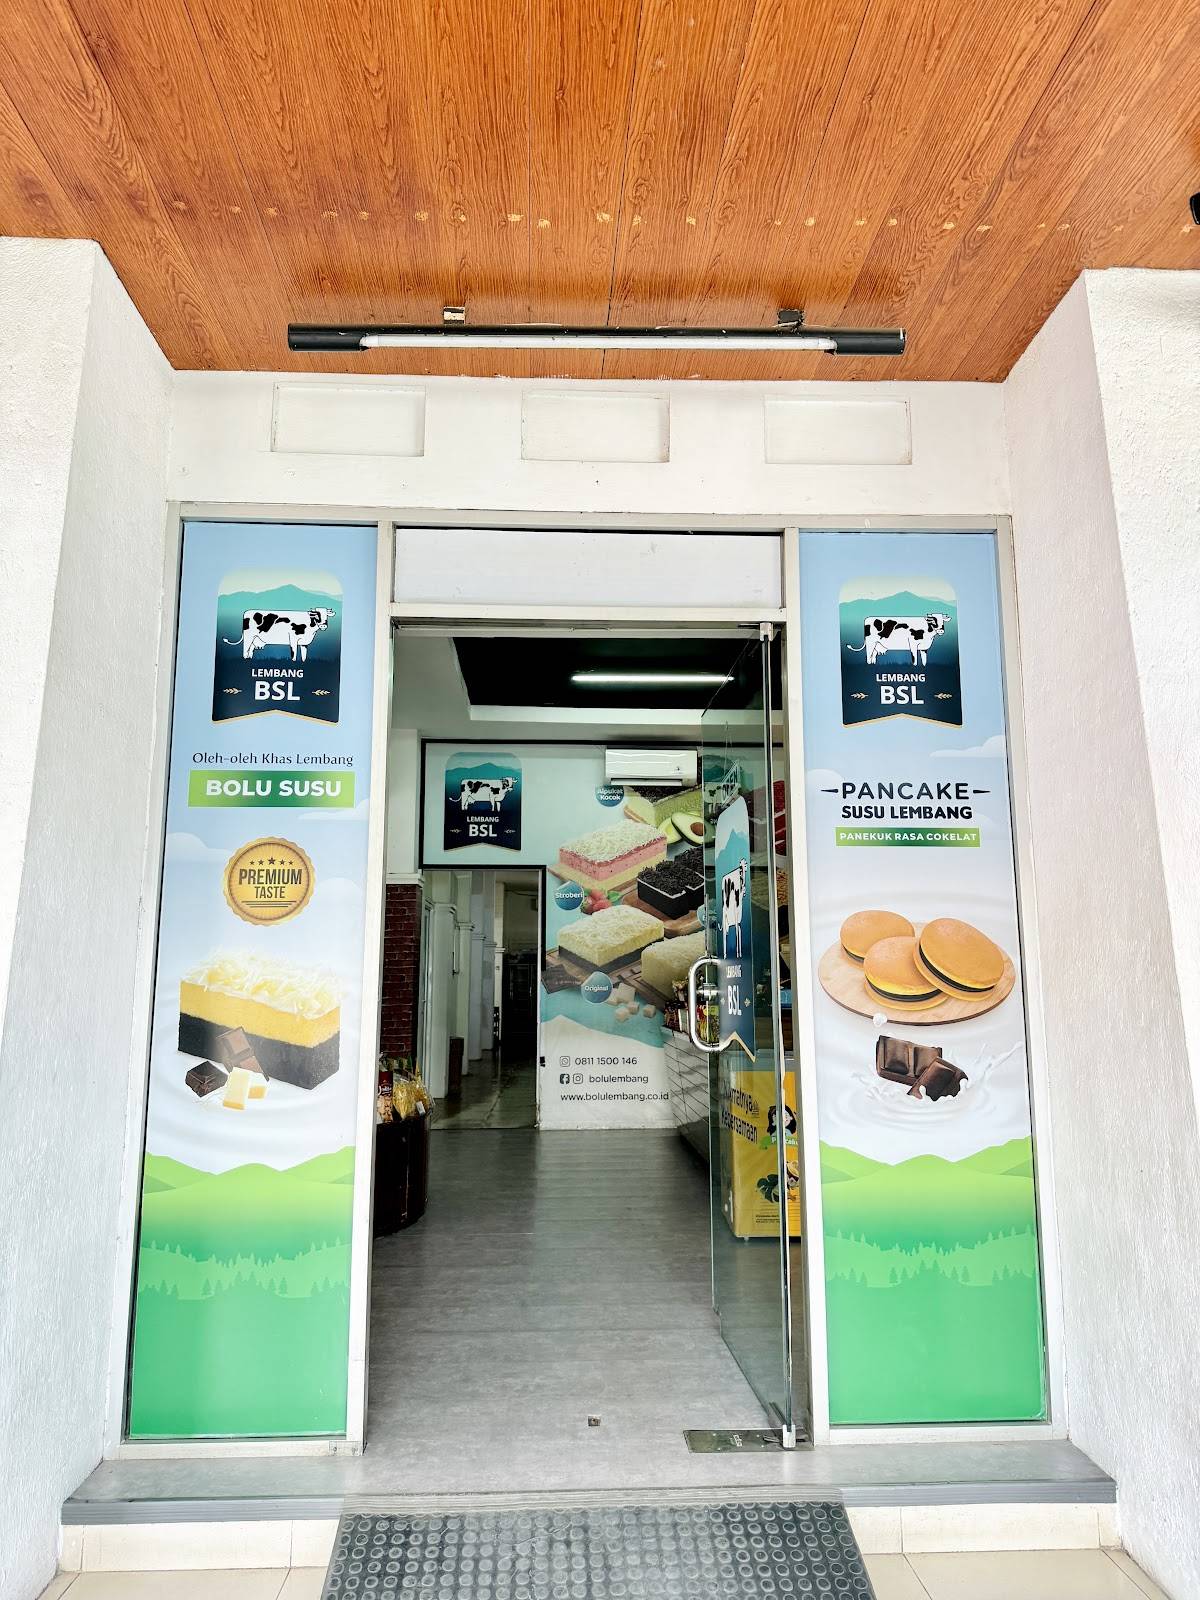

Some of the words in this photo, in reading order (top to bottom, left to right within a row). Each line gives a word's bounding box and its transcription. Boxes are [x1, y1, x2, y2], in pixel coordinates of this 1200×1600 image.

[251, 668, 304, 678] LEMBANG
[876, 673, 926, 682] LEMBANG
[254, 680, 300, 701] BSL
[880, 685, 925, 705] BSL
[192, 752, 257, 764] Oleh-oleh
[262, 753, 292, 765] Khas
[296, 753, 353, 767] Lembang
[205, 779, 272, 797] BOLU
[279, 780, 342, 797] SUSU
[842, 782, 970, 800] PANCAKE
[841, 805, 885, 819] SUSU
[890, 805, 973, 820] LEMBANG
[468, 824, 498, 837] BSL
[839, 831, 893, 841] PANEKUK
[894, 831, 924, 841] RASA
[926, 831, 977, 841] COKELAT
[238, 868, 303, 885] PREMIUM
[254, 886, 286, 899] TASTE
[584, 985, 609, 993] Original
[727, 985, 742, 1016] BSL
[574, 1057, 594, 1065] 0811
[597, 1057, 619, 1065] 1500
[622, 1057, 638, 1065] 146
[588, 1074, 649, 1084] bolulembang
[560, 1092, 669, 1102] www.bolulembang.co.id
